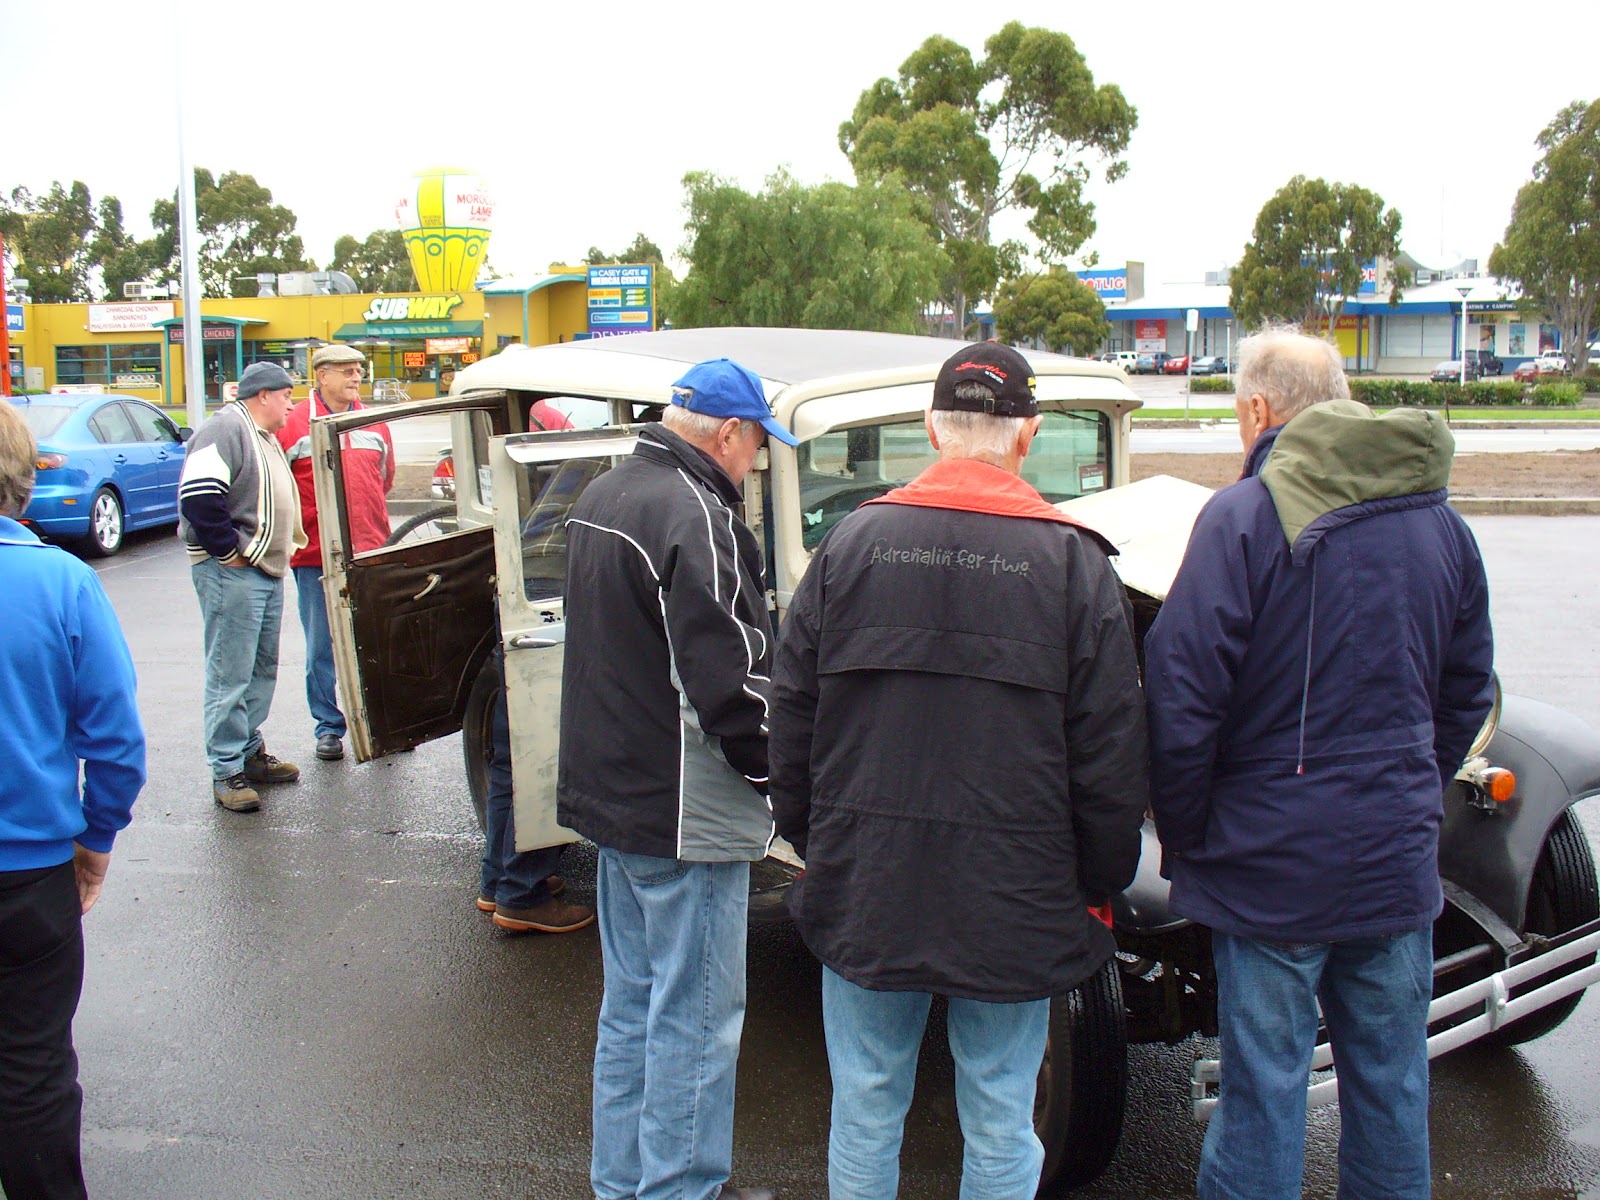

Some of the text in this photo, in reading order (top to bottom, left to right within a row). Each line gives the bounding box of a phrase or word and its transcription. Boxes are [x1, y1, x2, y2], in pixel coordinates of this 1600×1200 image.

[621, 268, 640, 276] GATE
[621, 276, 648, 285] CENTRE
[362, 294, 463, 321] SUBWAY
[204, 329, 235, 338] CHICKENS
[870, 547, 1030, 577] Adrenalin for two
